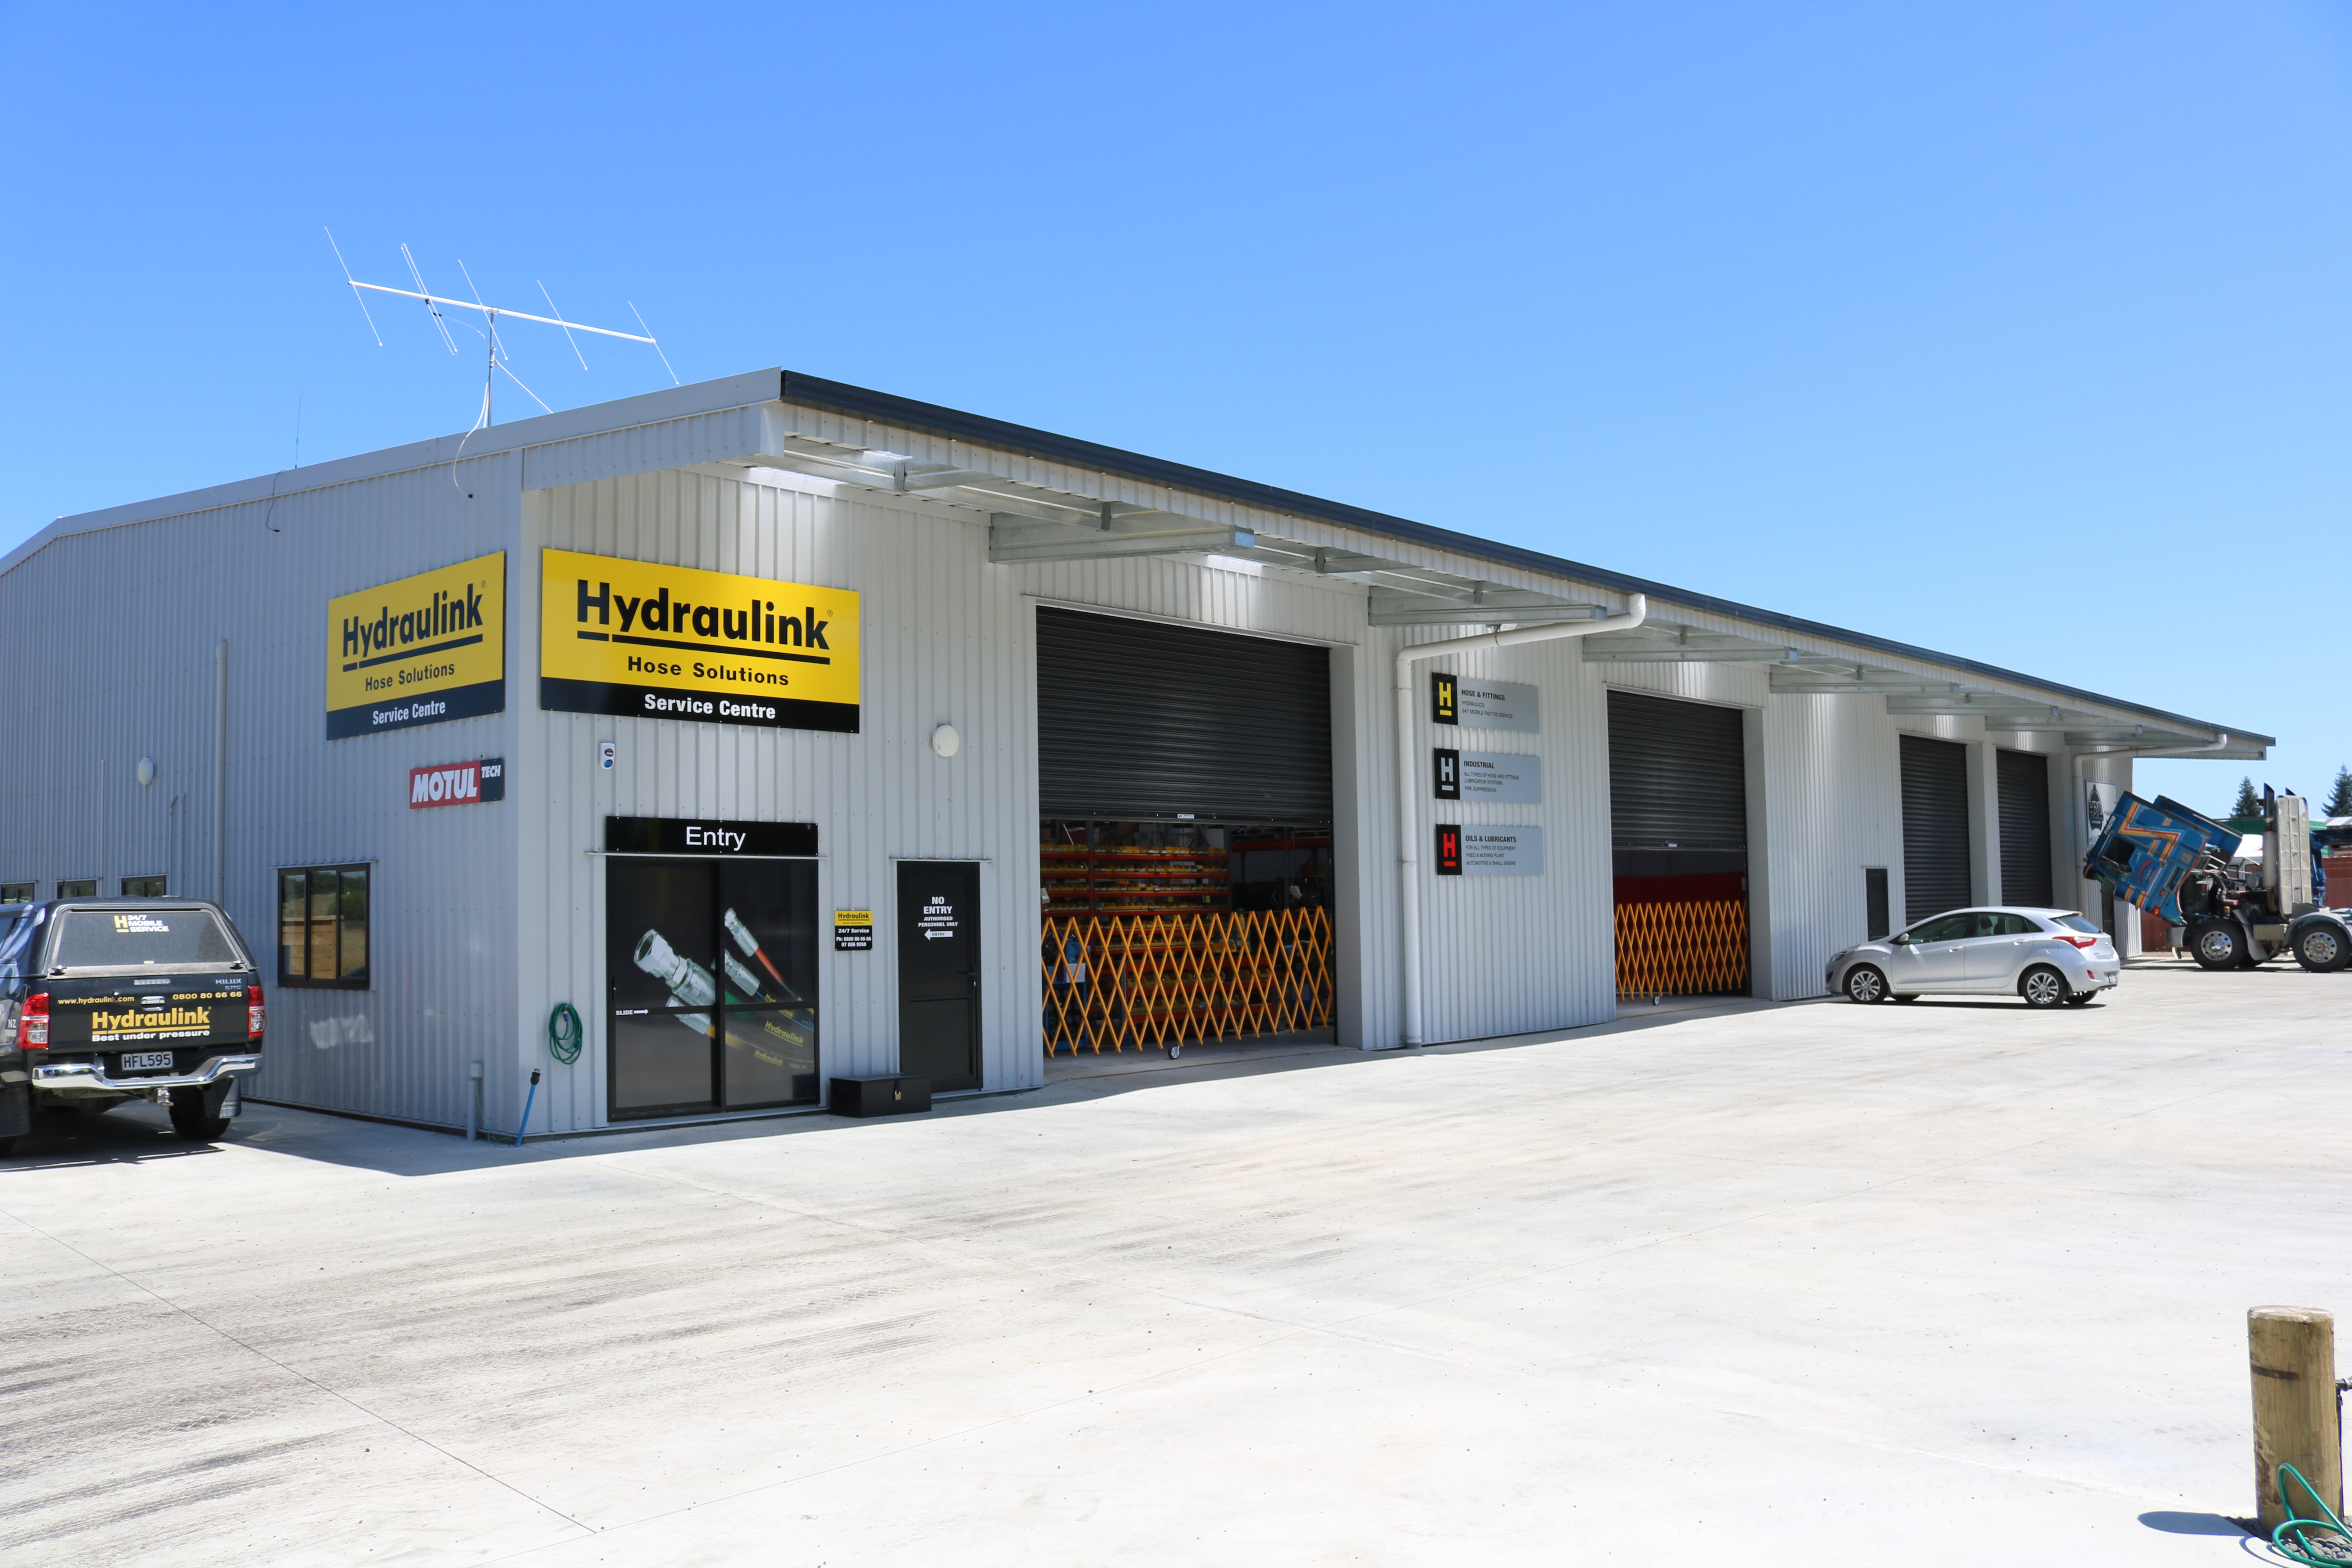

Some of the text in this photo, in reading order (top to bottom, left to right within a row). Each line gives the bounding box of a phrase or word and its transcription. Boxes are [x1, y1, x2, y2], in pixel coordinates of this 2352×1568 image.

[343, 583, 483, 658] Hydraulink
[577, 579, 830, 650] Hydraulink
[365, 664, 455, 691] Hose Solutions
[628, 656, 789, 685] Hose Solutions
[644, 694, 776, 719] Service Centre
[1483, 692, 1505, 701] FITTINGS
[373, 701, 445, 725] Service Centre
[1464, 760, 1495, 769] INDUSTRIAL
[412, 765, 501, 803] MOTUL TECH
[686, 826, 746, 851] Entry
[923, 906, 953, 914] ENTRY
[932, 896, 945, 904] NO
[8, 1019, 16, 1027] NZ
[92, 1006, 210, 1030] Hydraulink
[92, 1034, 120, 1042] Best
[159, 1030, 210, 1040] pressure
[765, 1020, 804, 1044] Hydraulink
[124, 1054, 171, 1067] HFL595
[755, 1049, 783, 1065] Hydraulink
